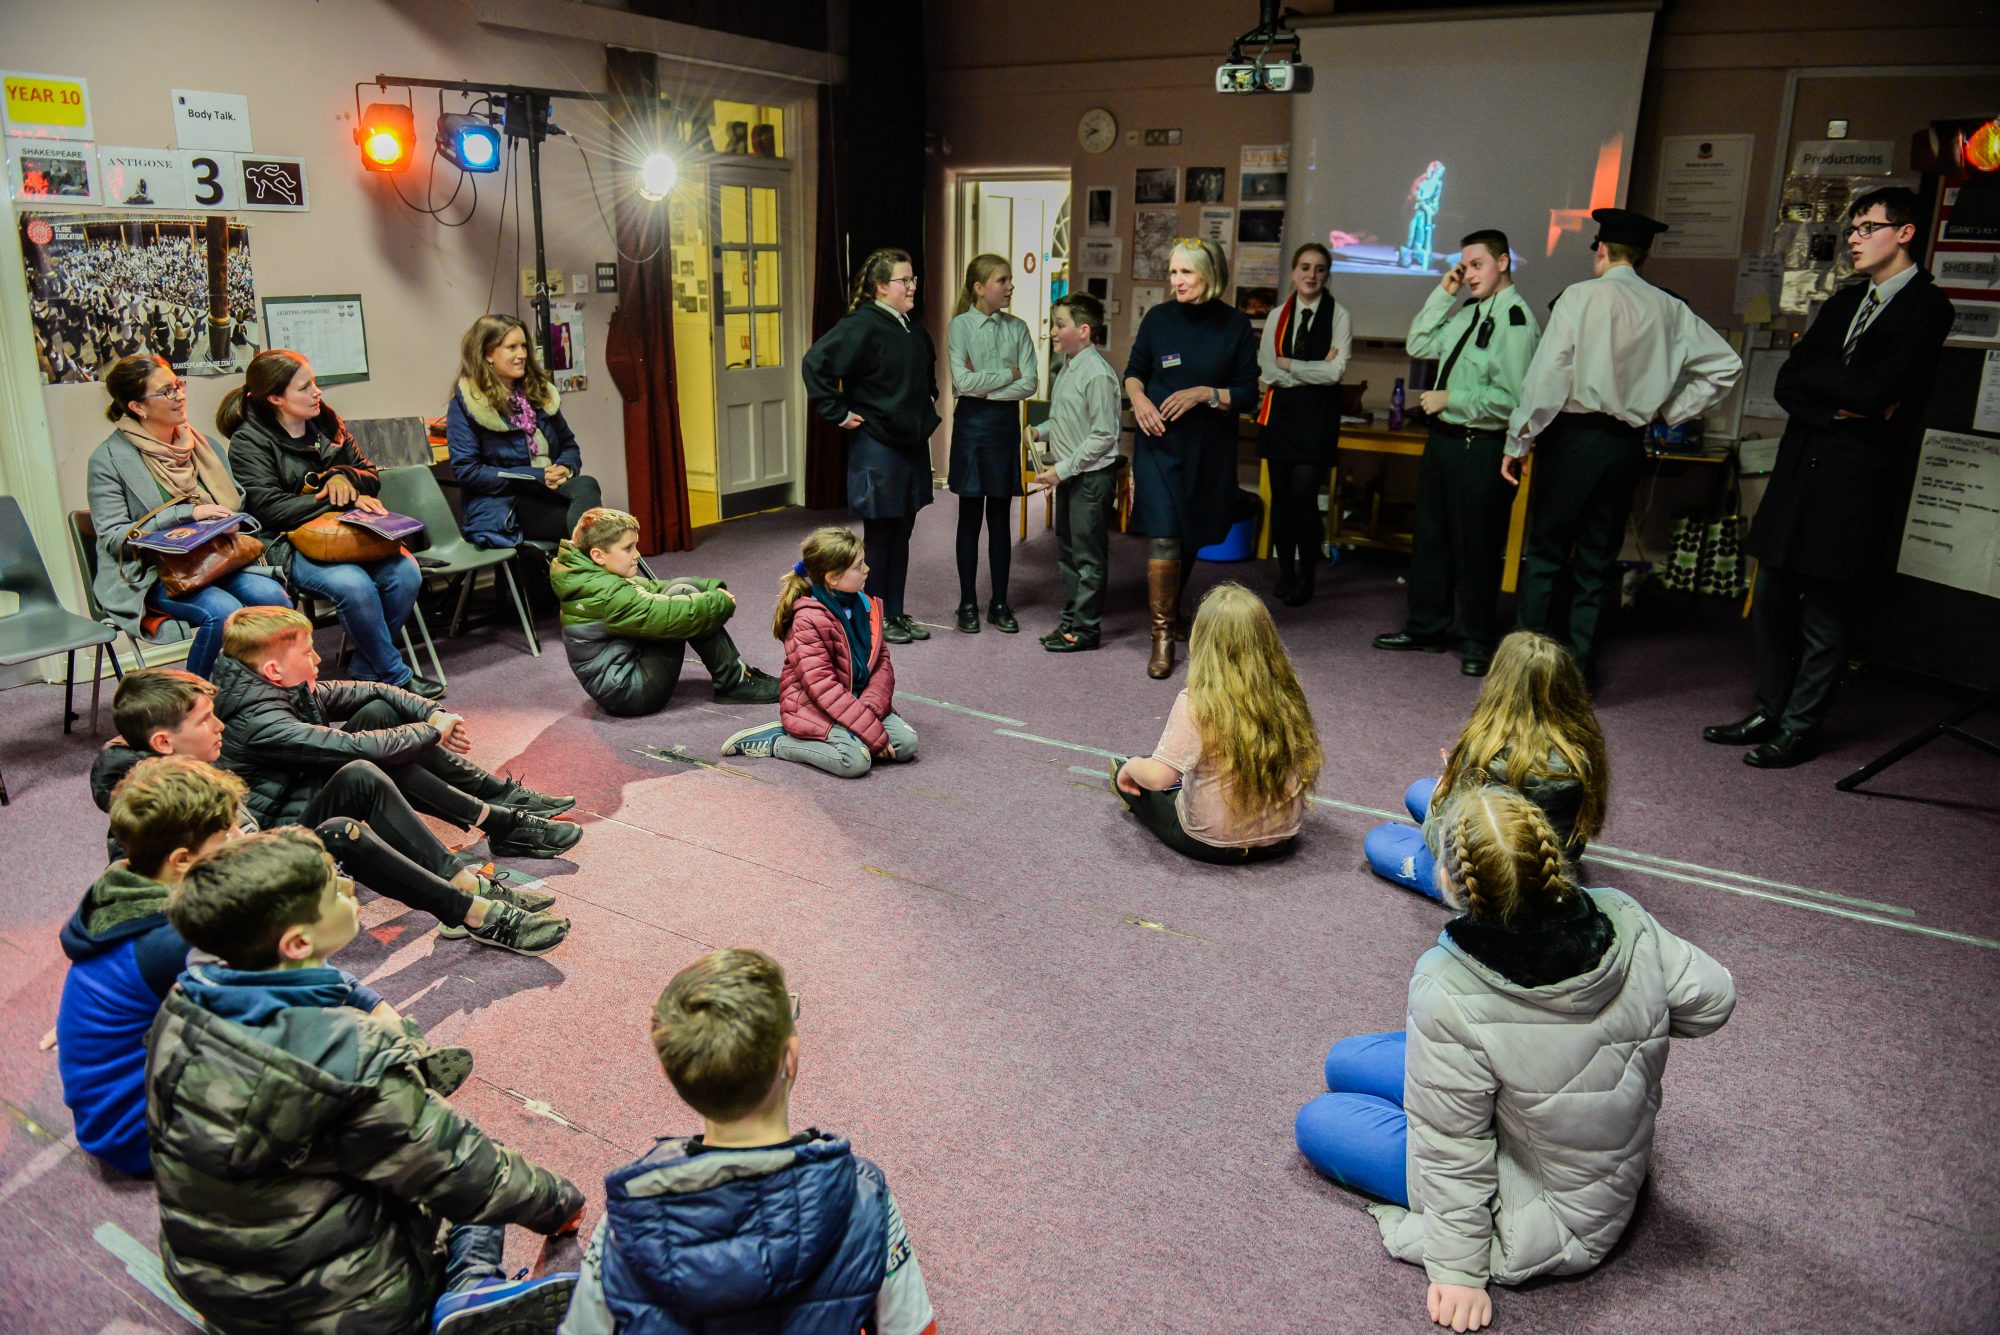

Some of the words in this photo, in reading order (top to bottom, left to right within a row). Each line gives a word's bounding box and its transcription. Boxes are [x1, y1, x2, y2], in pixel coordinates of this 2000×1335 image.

[7, 85, 55, 103] YEAR
[60, 90, 81, 105] 10
[188, 109, 212, 121] Body
[214, 111, 236, 121] Talk.
[22, 148, 83, 158] SHAKESPEARE
[1803, 153, 1883, 165] Productions
[108, 158, 173, 169] ANTIGONE
[191, 157, 225, 205] 3
[1942, 262, 1971, 273] SHOE
[1975, 263, 1998, 274] PILE
